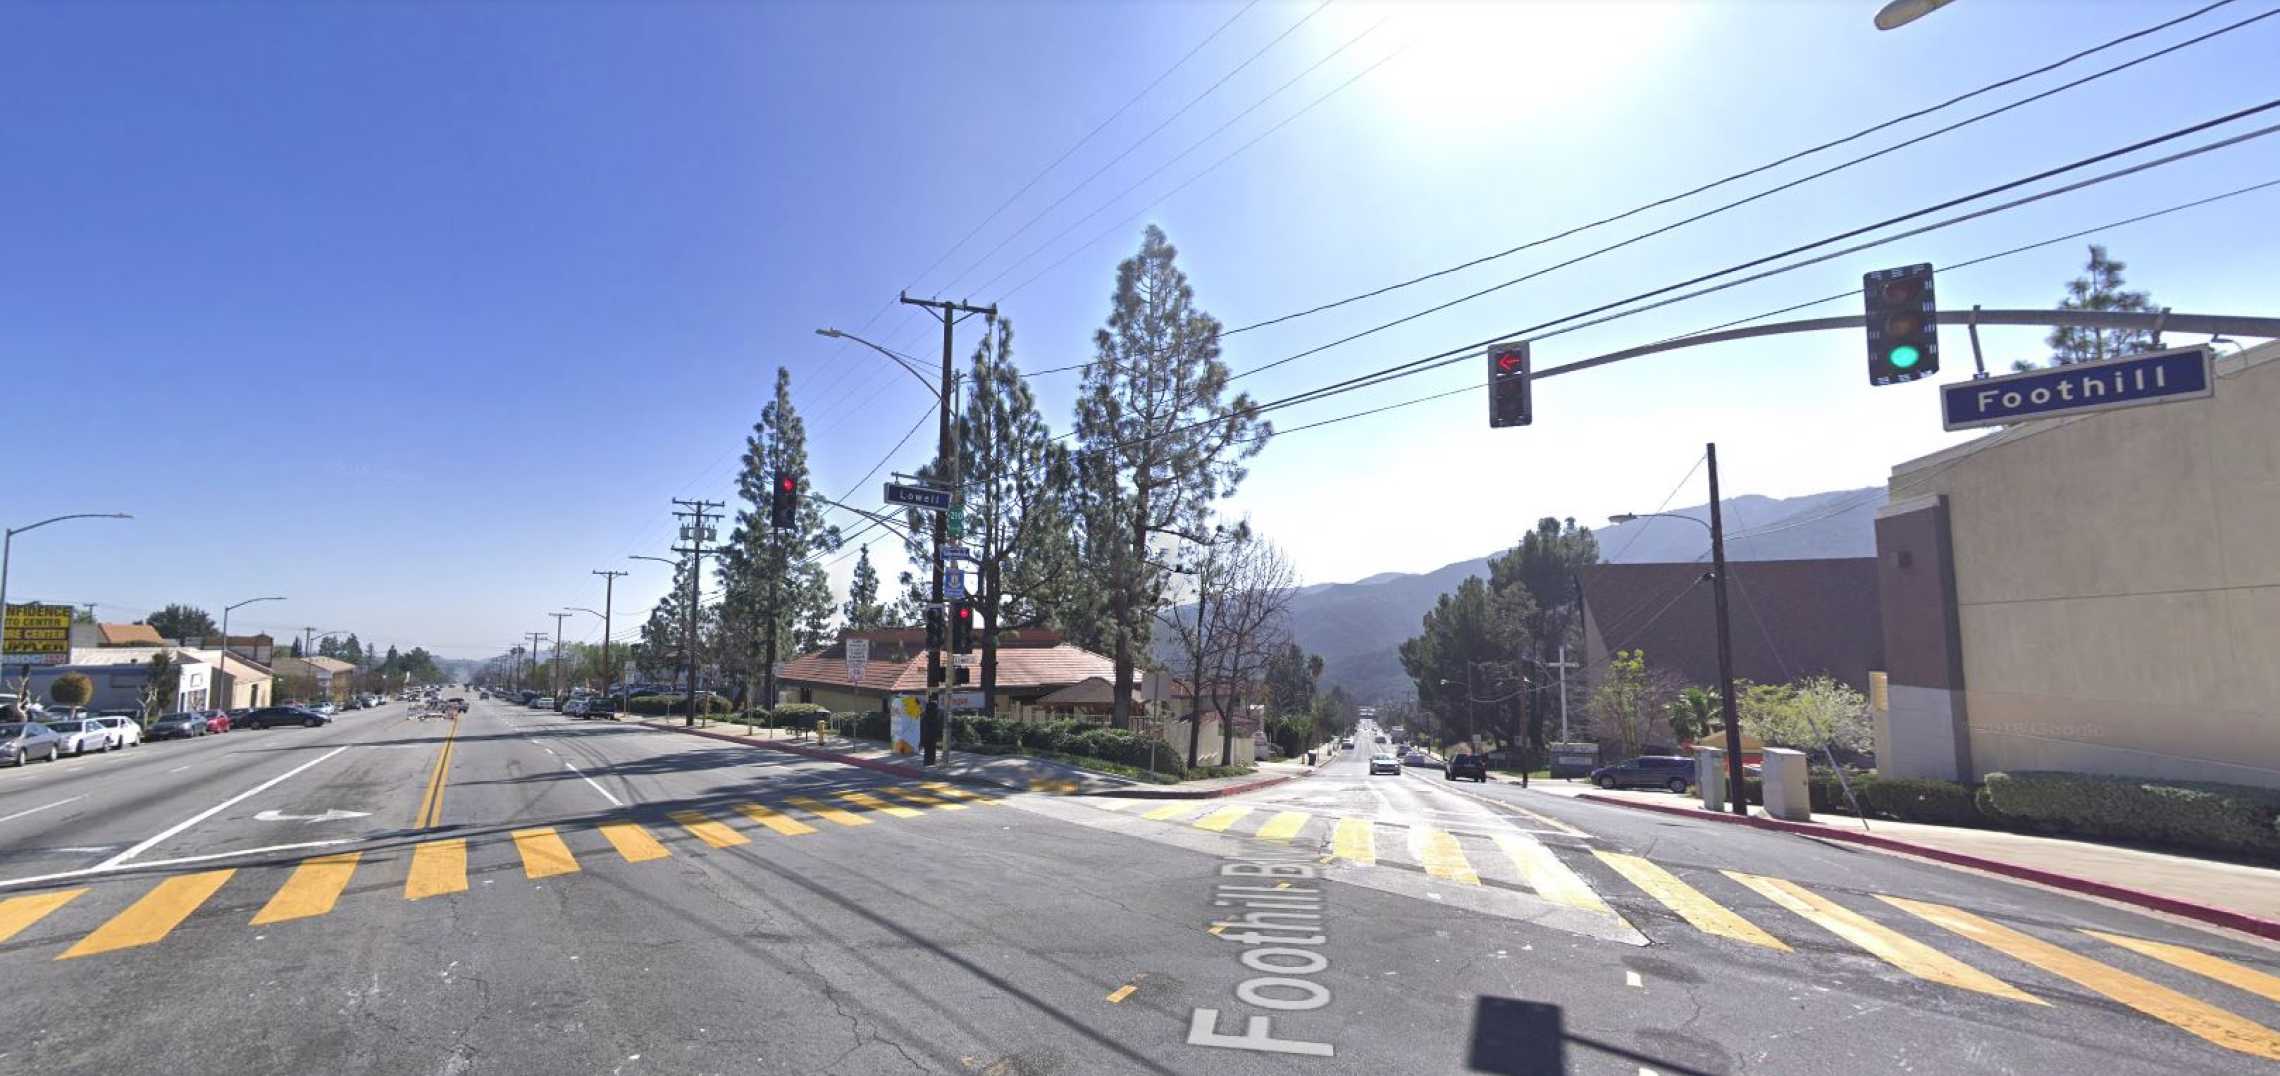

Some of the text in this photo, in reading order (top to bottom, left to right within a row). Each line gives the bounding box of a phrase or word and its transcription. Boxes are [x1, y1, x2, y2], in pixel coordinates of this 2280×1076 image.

[1978, 366, 2165, 412] Foothill
[900, 488, 940, 504] Lowell
[24, 618, 61, 626] CENTER
[24, 629, 65, 639] CENTER
